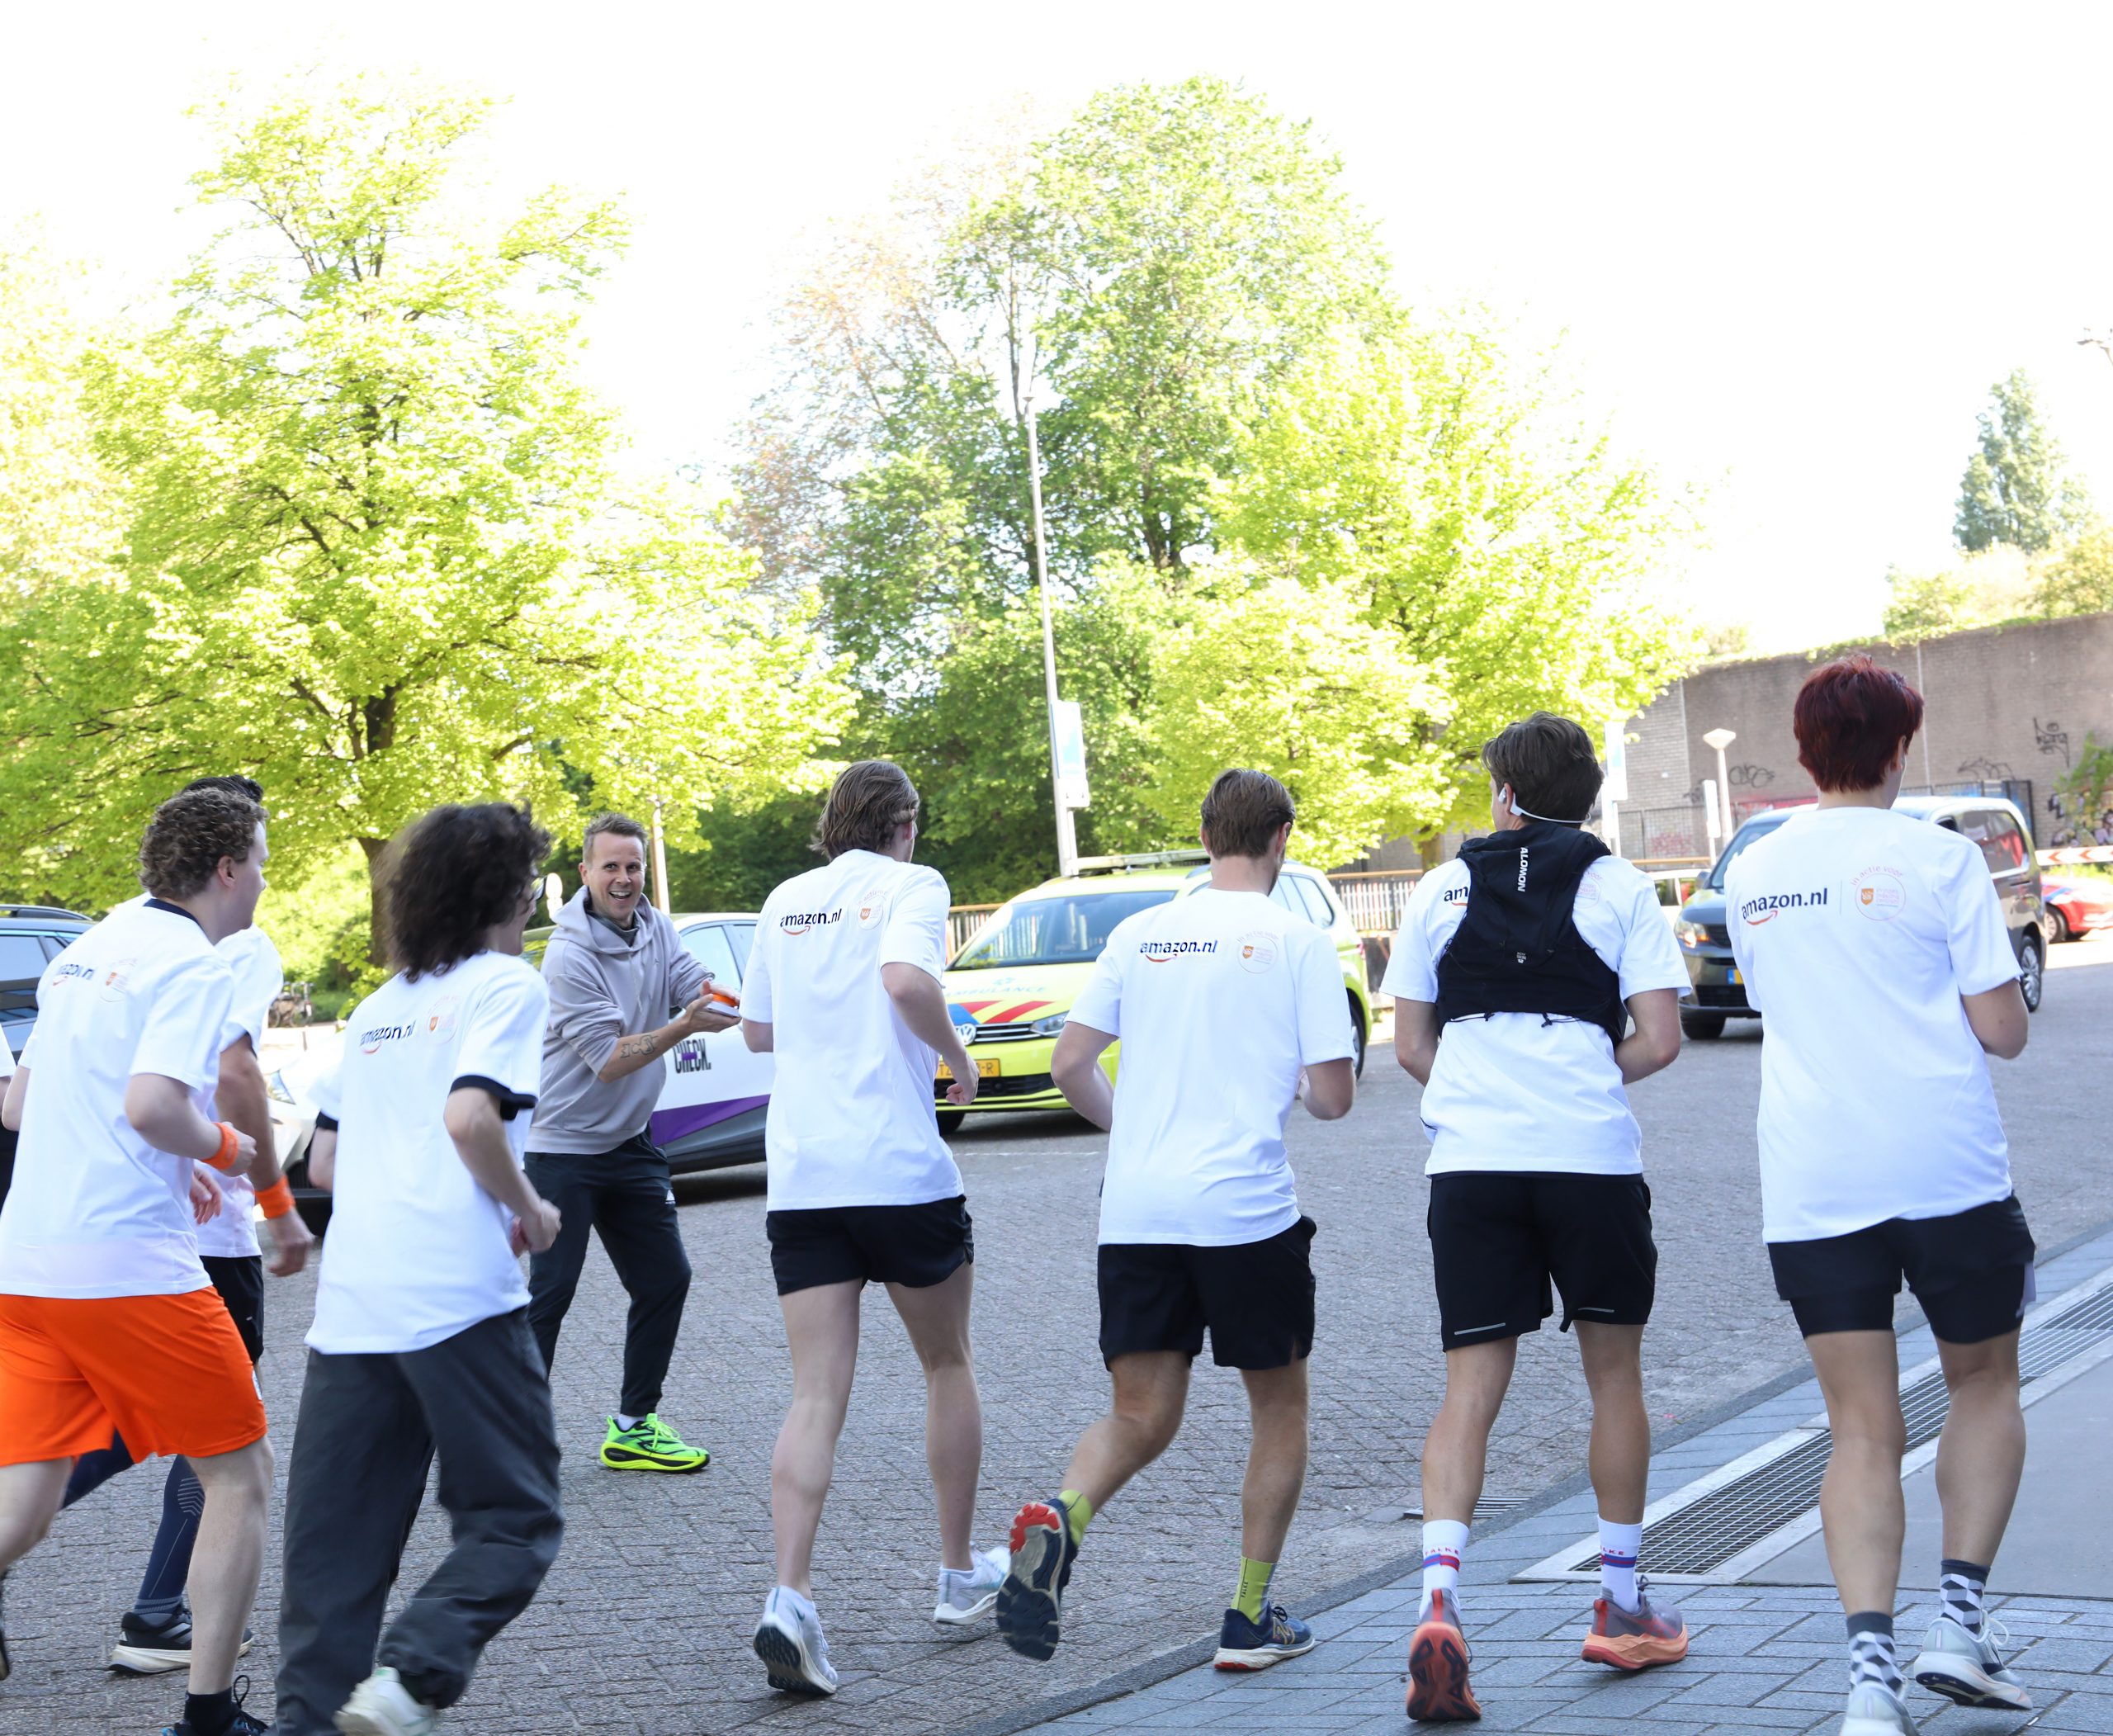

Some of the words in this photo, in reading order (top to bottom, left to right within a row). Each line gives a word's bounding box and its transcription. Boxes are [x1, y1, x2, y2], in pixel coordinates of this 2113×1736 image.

[1443, 886, 1468, 902] am
[1742, 887, 1827, 920] amazon.nl
[779, 908, 842, 928] amazon.nl
[1139, 939, 1218, 953] amazon.nl
